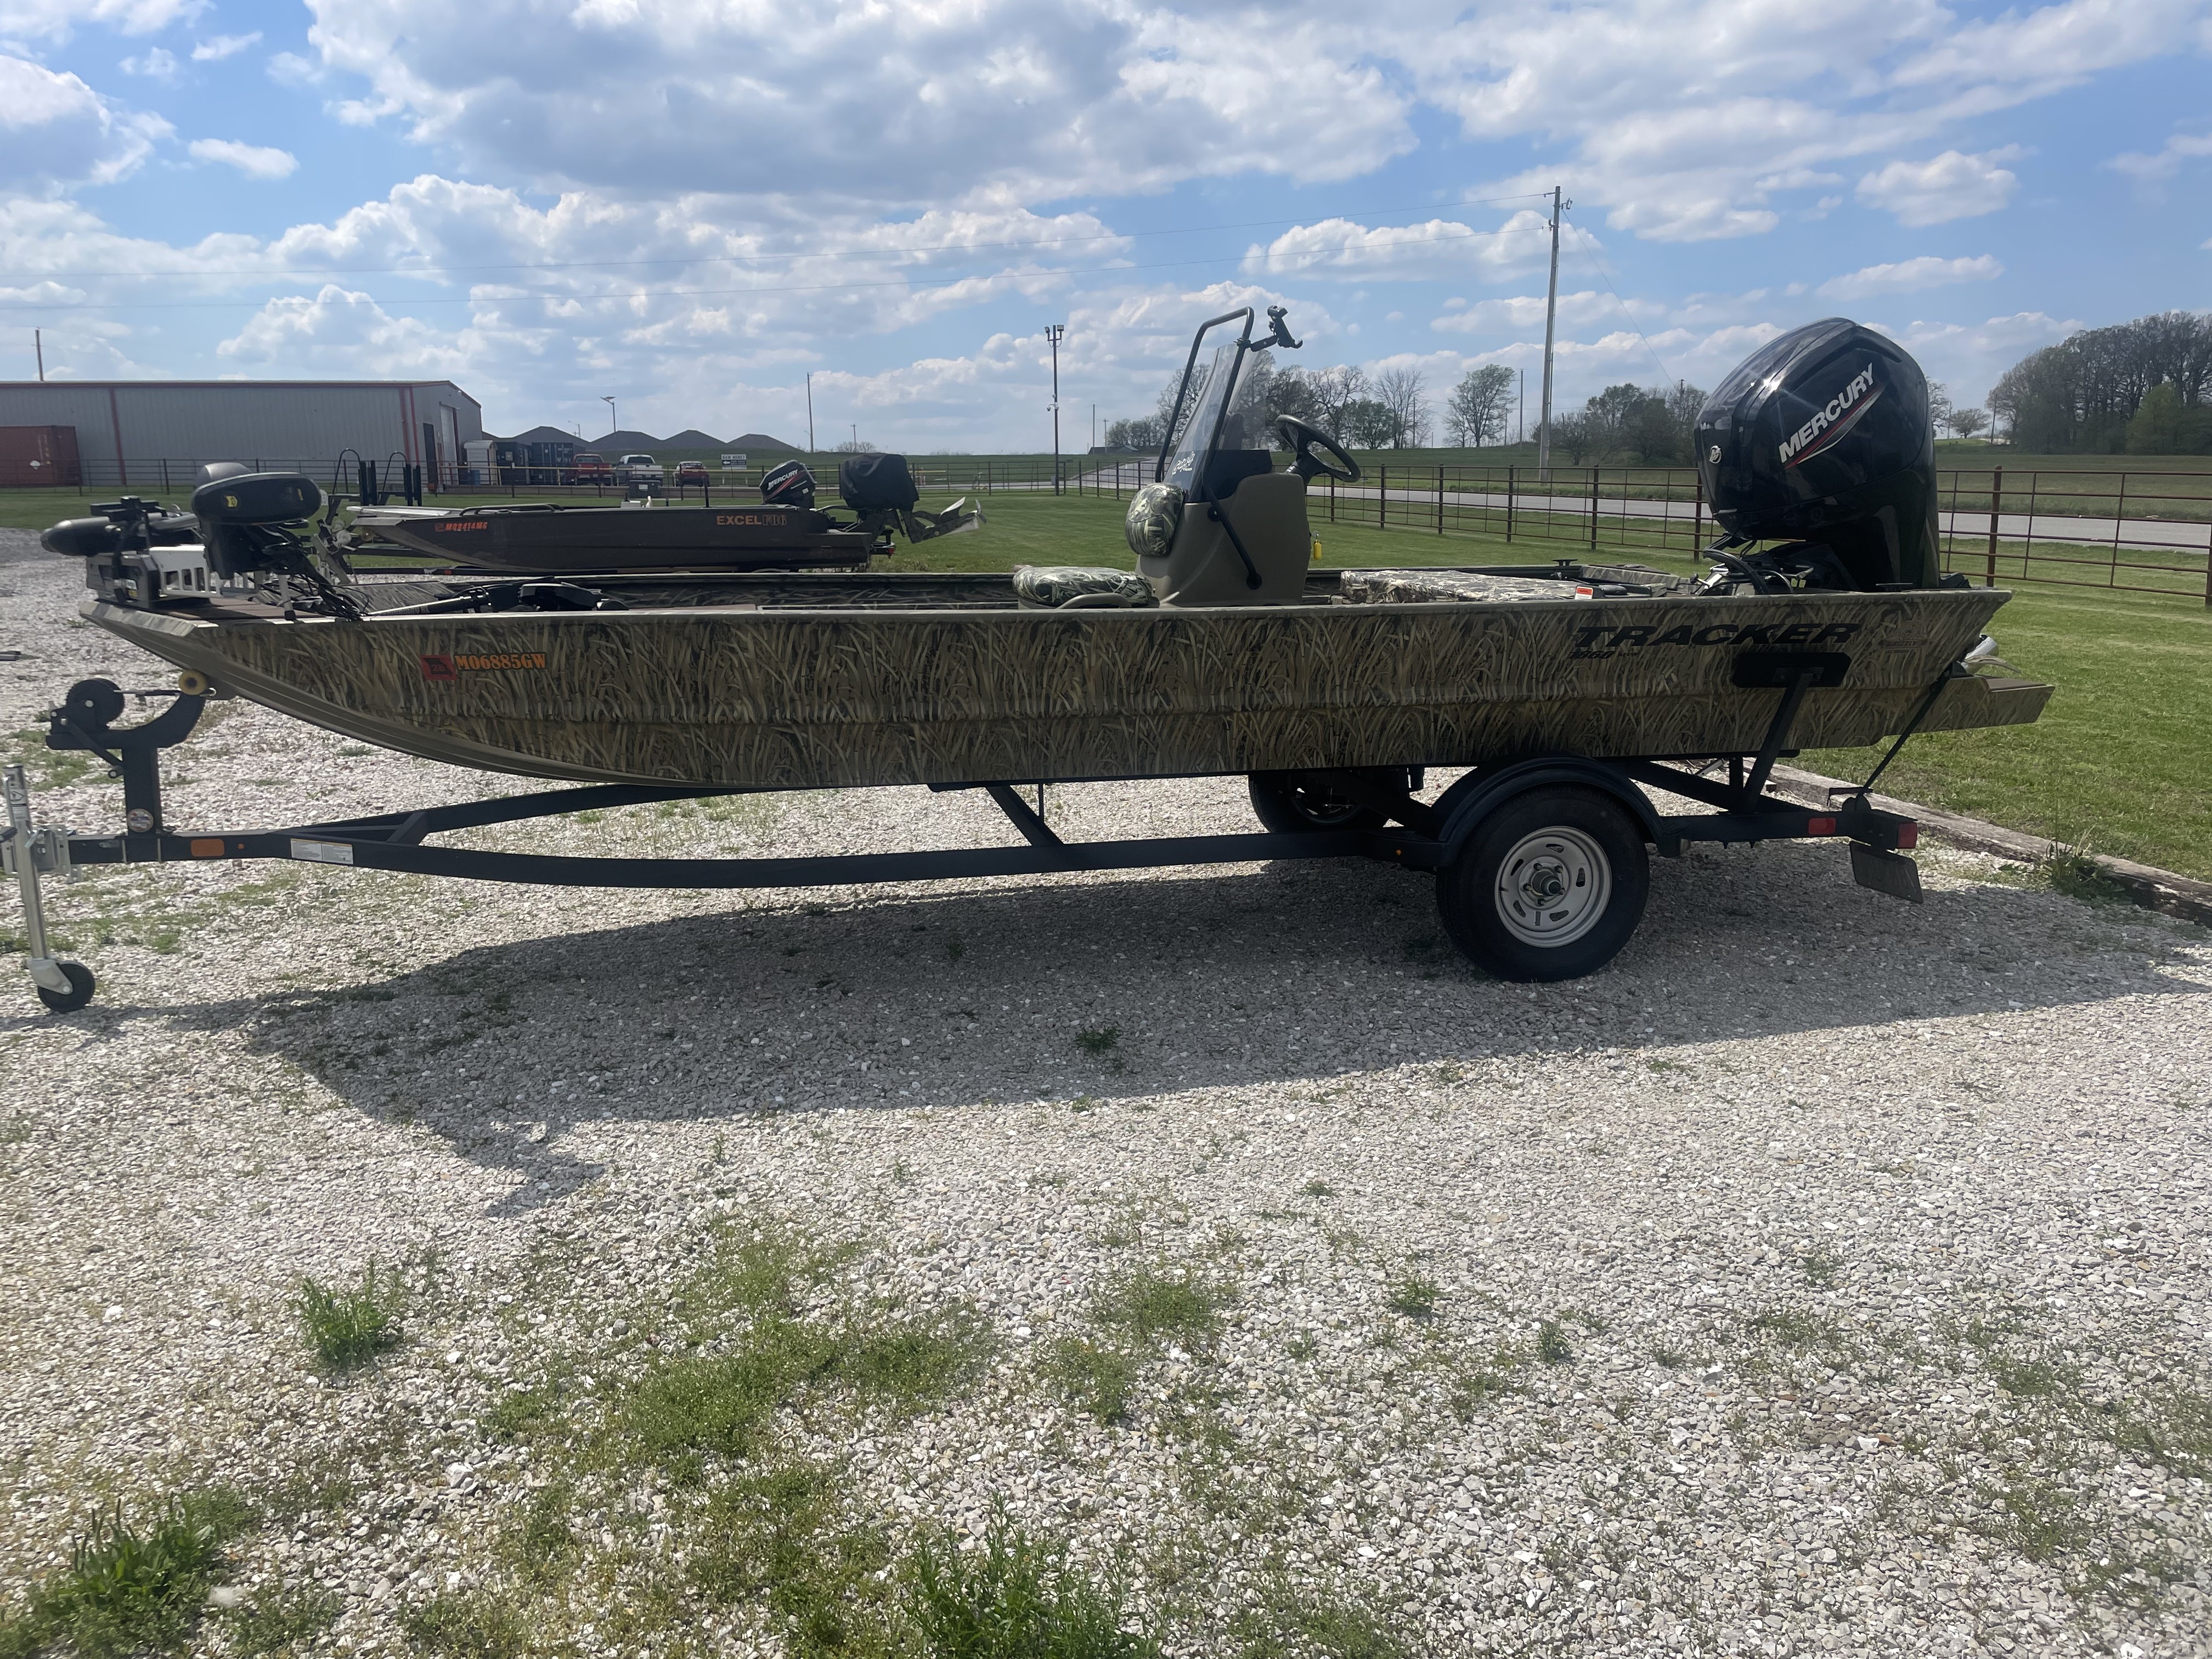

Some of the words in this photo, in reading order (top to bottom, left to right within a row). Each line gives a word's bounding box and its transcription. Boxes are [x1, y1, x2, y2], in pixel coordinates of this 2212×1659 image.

[1778, 362, 1874, 464] MERCURY
[767, 469, 798, 490] MERCURY
[716, 515, 762, 525] EXCEL
[1575, 623, 1861, 647] TRACKER
